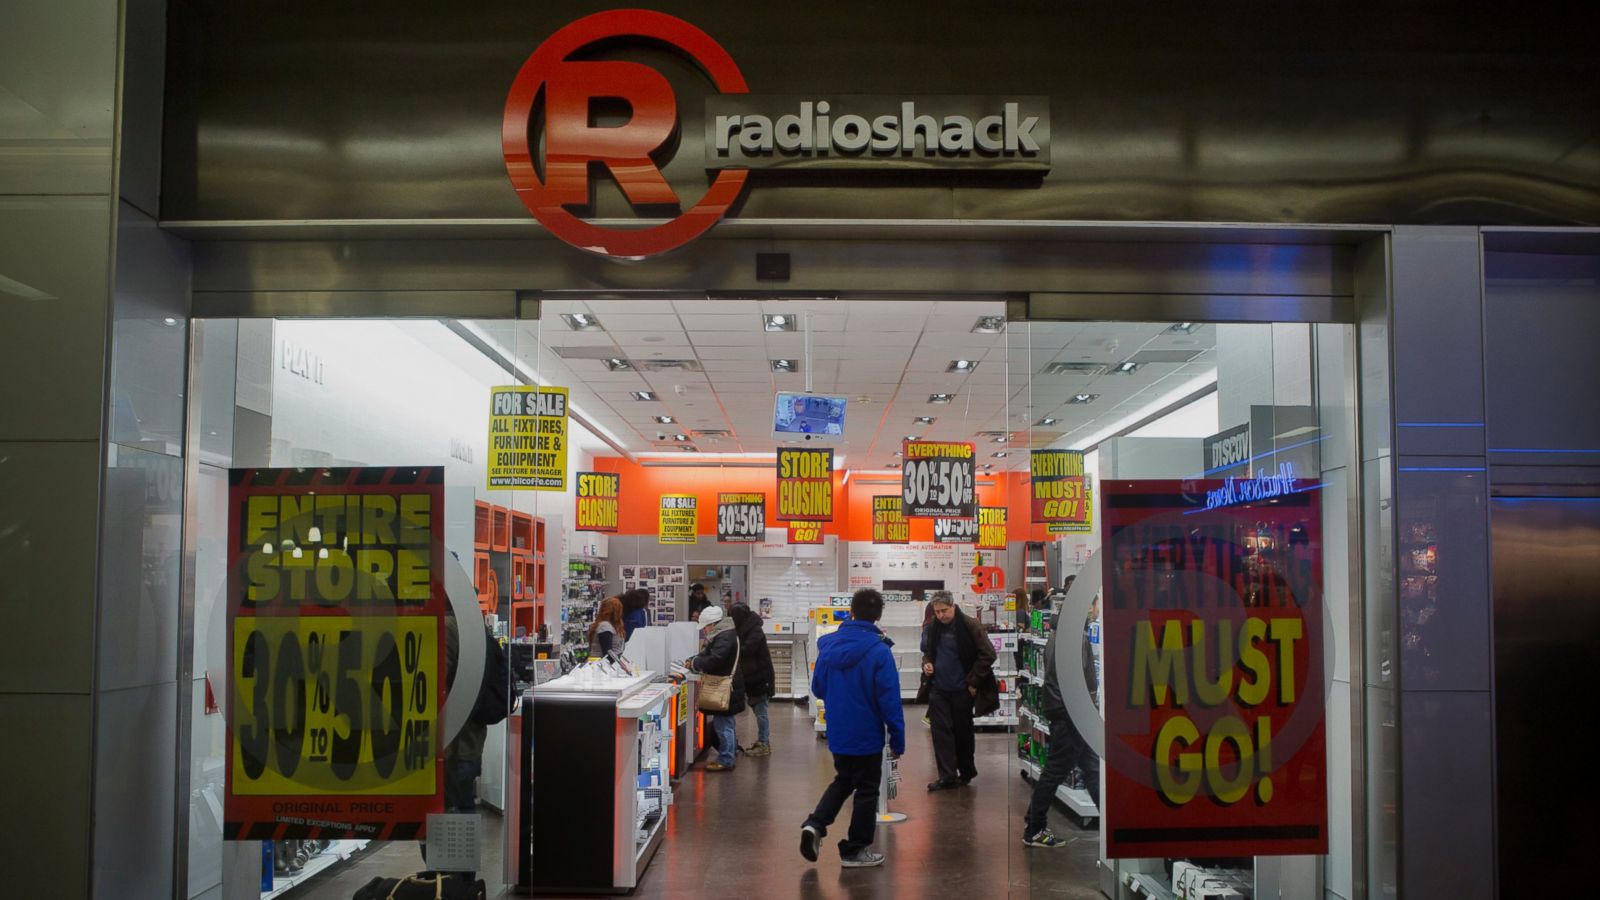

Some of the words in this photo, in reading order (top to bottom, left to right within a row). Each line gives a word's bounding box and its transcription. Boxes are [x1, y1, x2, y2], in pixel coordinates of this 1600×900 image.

[715, 101, 1040, 153] radioshack
[494, 393, 521, 415] FOR
[526, 393, 564, 416] SALE
[492, 419, 509, 433] ALL
[513, 419, 564, 436] FIXTURES,
[494, 436, 550, 450] FURNITURE
[553, 436, 561, 451] &
[907, 443, 971, 459] EVERYTHING
[1212, 431, 1249, 469] DISCOV
[497, 452, 557, 467] EQUIPMENT
[780, 451, 830, 479] STORE
[1032, 453, 1084, 477] EVERYTHING
[579, 474, 617, 497] STORE
[1035, 480, 1083, 499] MUST
[662, 498, 676, 508] FOR
[677, 498, 696, 508] SALE
[720, 494, 763, 503] EVERYTHING
[780, 480, 831, 516] CLOSING
[874, 498, 902, 510] ENTIR
[578, 498, 618, 528] CLOSING
[876, 510, 906, 523] STOR
[979, 508, 1006, 525] STORE
[1043, 500, 1078, 518] GO!
[246, 494, 432, 545] ENTIRE
[662, 517, 688, 525] FURNITURE
[664, 525, 692, 533] EQUIPMENT
[794, 529, 819, 541] GO!
[873, 524, 885, 540] ON
[887, 524, 909, 540] SALE!
[246, 549, 432, 601] STORE
[1111, 523, 1313, 609] EVERYTHING
[1131, 617, 1302, 706] MUST
[311, 728, 328, 762] TO
[404, 719, 430, 771] OFF
[1156, 715, 1273, 805] GO!
[272, 802, 343, 813] ORIGINAL
[350, 802, 394, 813] PRICE
[276, 815, 304, 825] LIMITED
[306, 819, 353, 831] EXCEPTIONS
[354, 824, 377, 833] APPLY
